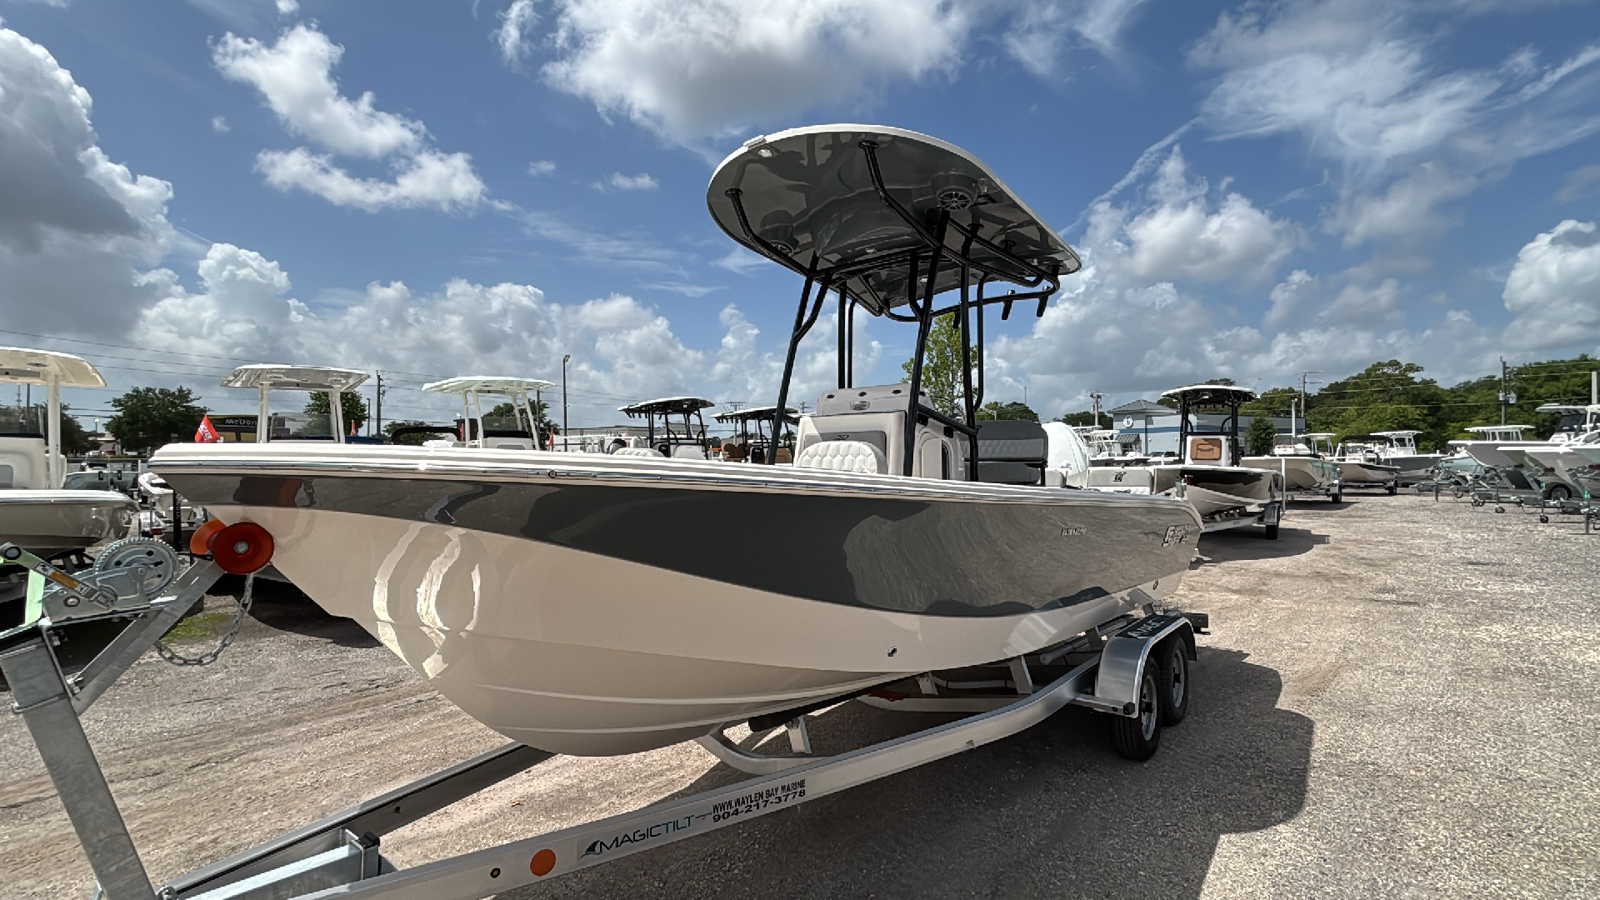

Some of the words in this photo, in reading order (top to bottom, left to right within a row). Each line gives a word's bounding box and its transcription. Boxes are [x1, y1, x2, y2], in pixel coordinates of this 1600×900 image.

[225, 418, 257, 426] McDon
[712, 790, 764, 814] WWW.WAYLEN
[765, 786, 779, 799] BAY
[780, 778, 806, 795] MARINE
[712, 788, 806, 823] 904-217-3778
